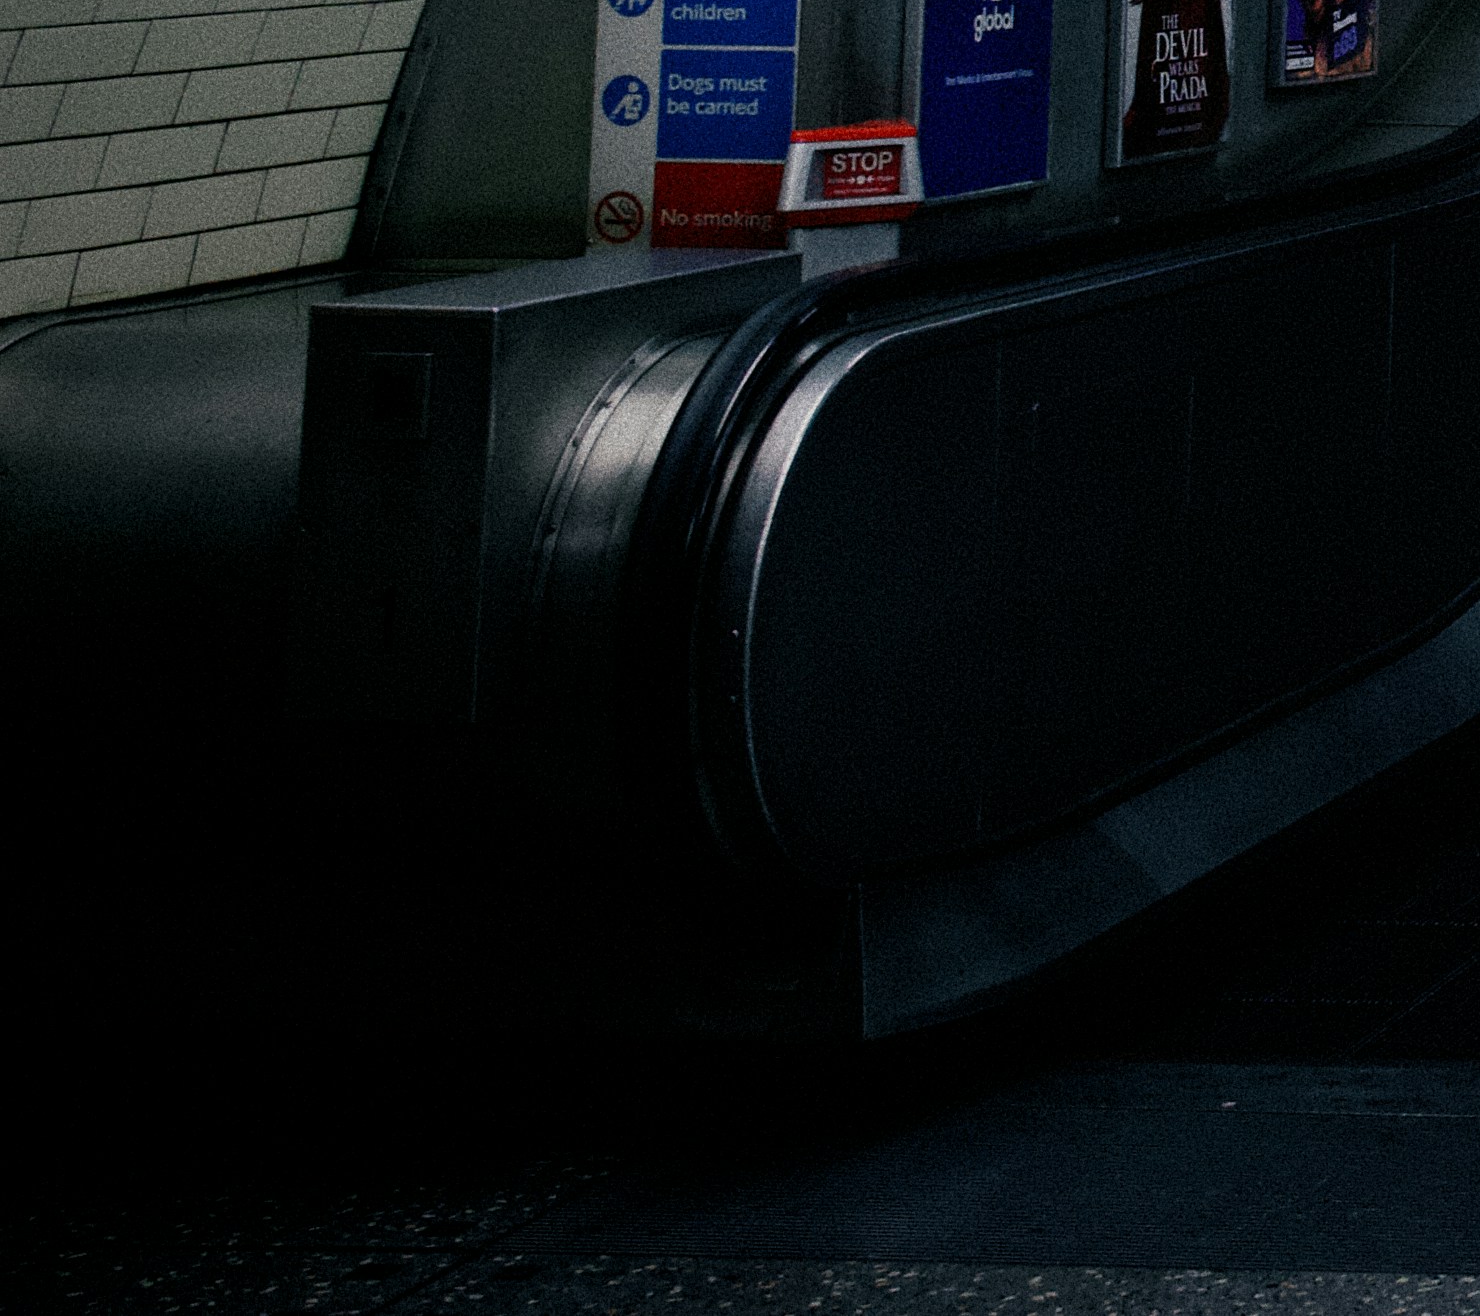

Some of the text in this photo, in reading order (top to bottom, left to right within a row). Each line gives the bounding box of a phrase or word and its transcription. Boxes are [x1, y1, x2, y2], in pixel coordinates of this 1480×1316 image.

[670, 4, 747, 21] children
[973, 2, 1016, 44] global
[1161, 13, 1179, 30] THE
[1155, 27, 1209, 63] DEVIL
[1168, 58, 1200, 76] WEARS
[667, 73, 768, 96] Dogs must
[1158, 71, 1209, 105] PRADA
[666, 97, 759, 116] be carried
[831, 150, 894, 174] STOP
[659, 208, 774, 232] No smoking
